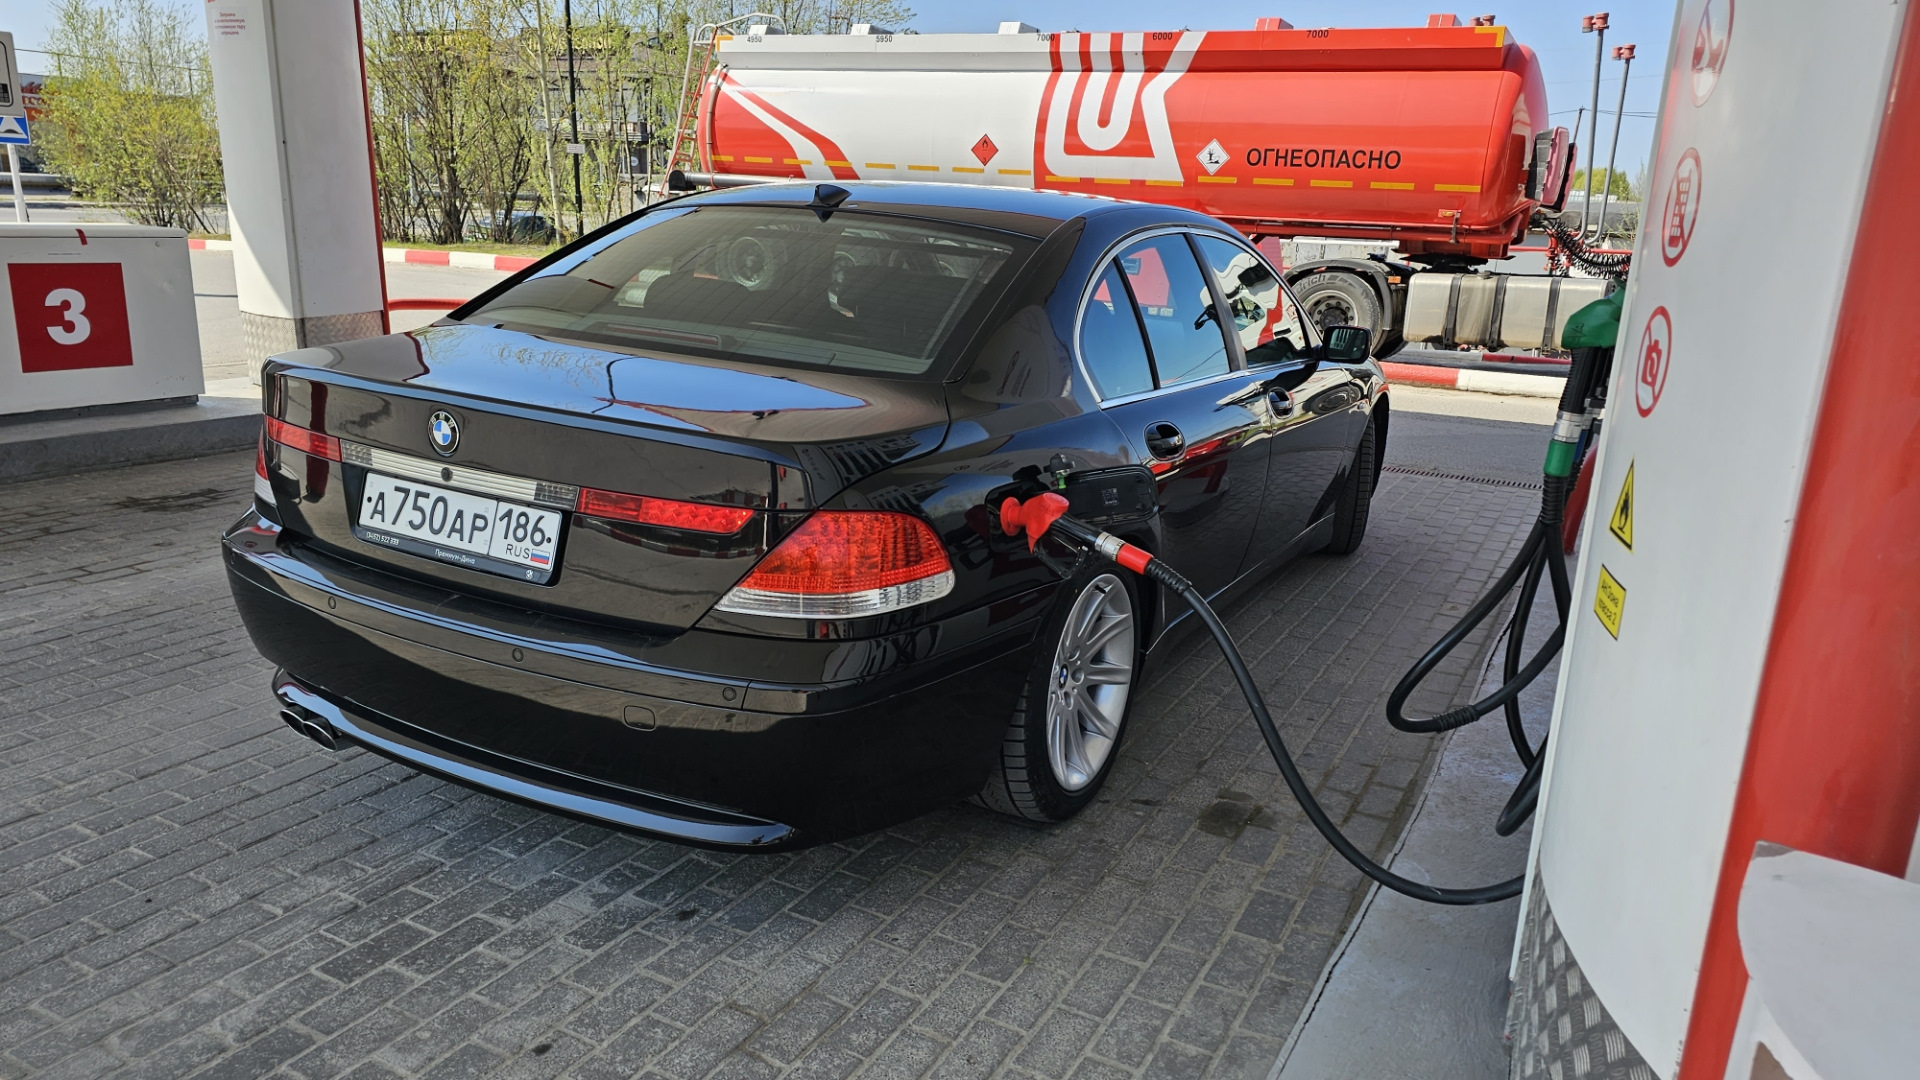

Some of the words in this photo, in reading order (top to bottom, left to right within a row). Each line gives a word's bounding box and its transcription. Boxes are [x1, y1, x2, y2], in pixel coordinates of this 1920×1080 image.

[875, 35, 893, 43] 5950
[1036, 33, 1055, 42] 7000
[1152, 32, 1173, 41] 6000
[1306, 29, 1329, 39] 7000
[1246, 147, 1402, 170] ОГНЕОПАСНО
[1296, 273, 1327, 293] drich
[44, 287, 91, 346] 3
[499, 508, 546, 547] 186
[505, 543, 530, 560] RUS
